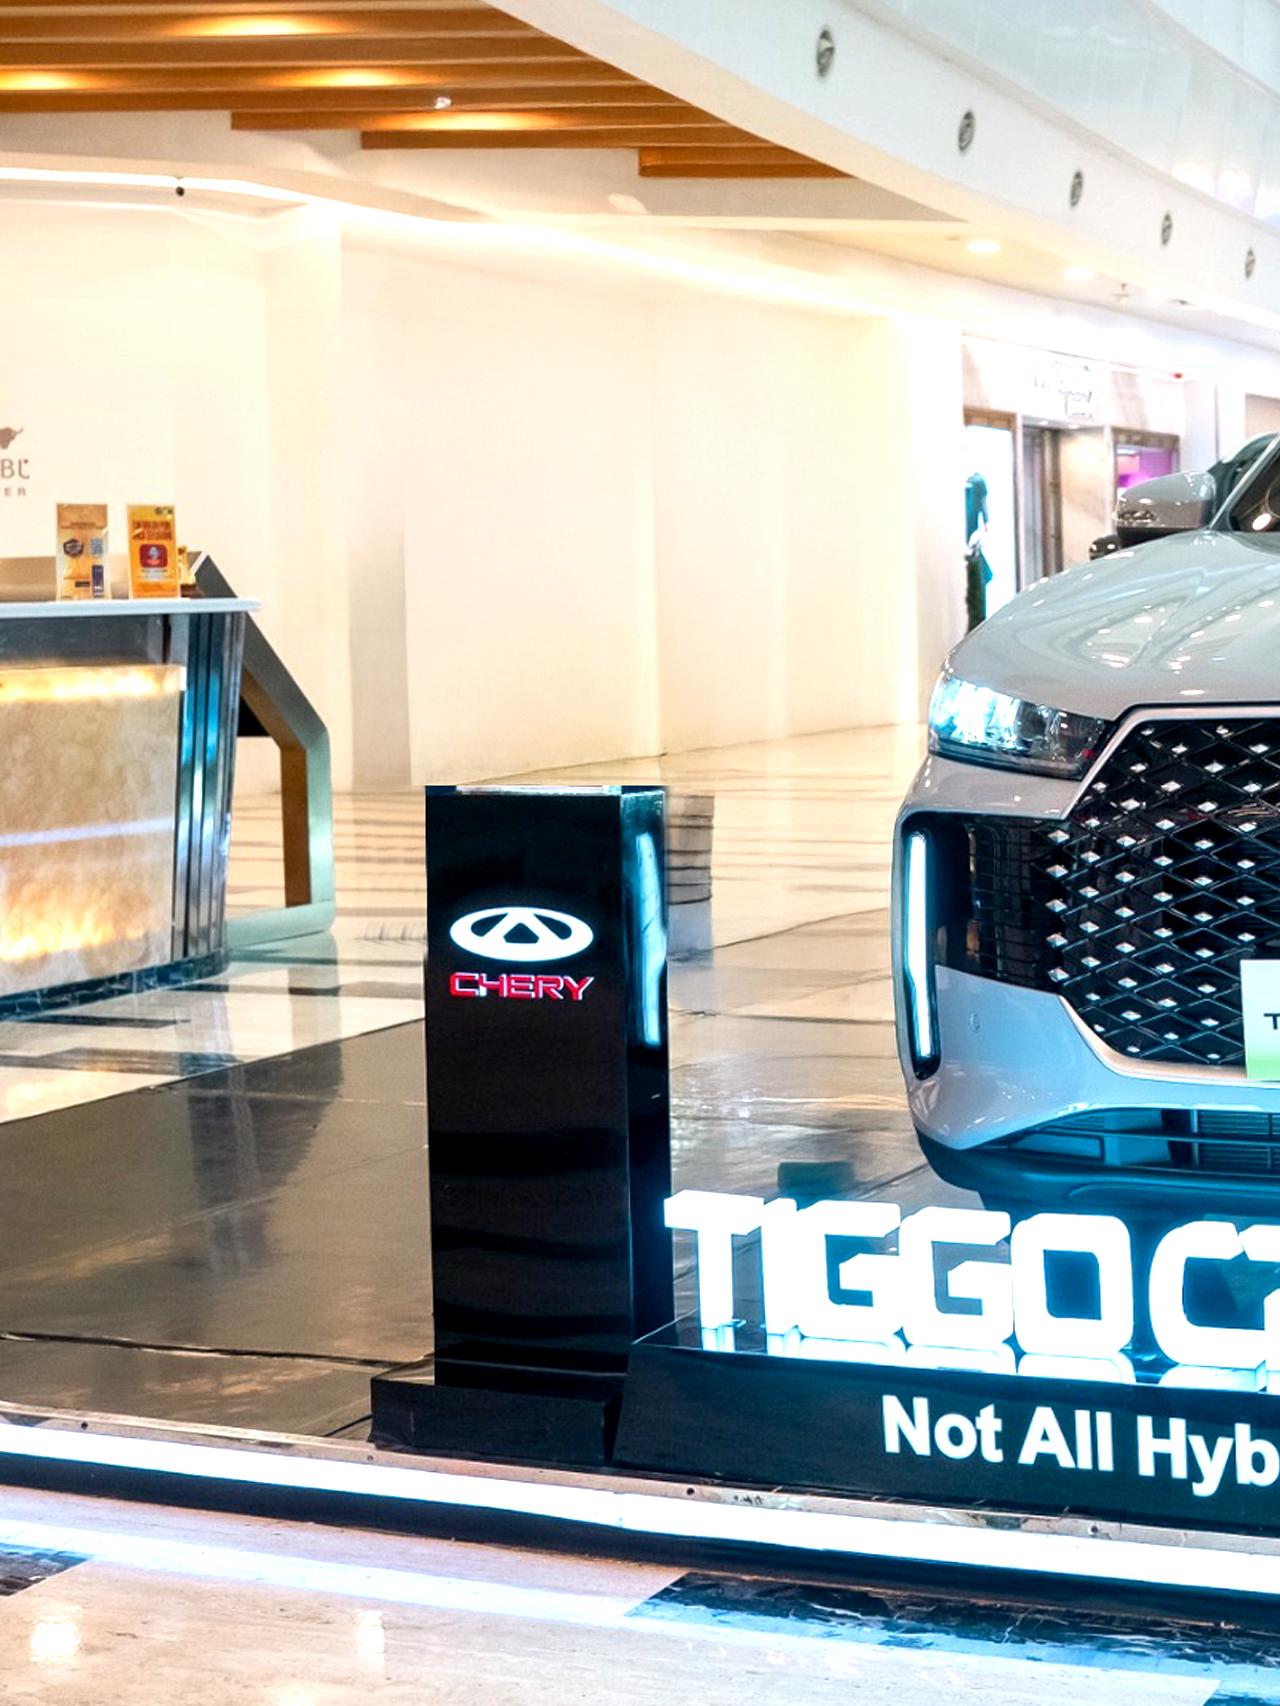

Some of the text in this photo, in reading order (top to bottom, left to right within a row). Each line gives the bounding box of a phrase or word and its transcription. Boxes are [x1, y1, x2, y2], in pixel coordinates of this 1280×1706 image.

[449, 971, 595, 1001] CHERY
[664, 1190, 1135, 1355] TIGGO
[881, 1394, 1003, 1462] Not
[1018, 1406, 1114, 1472] All
